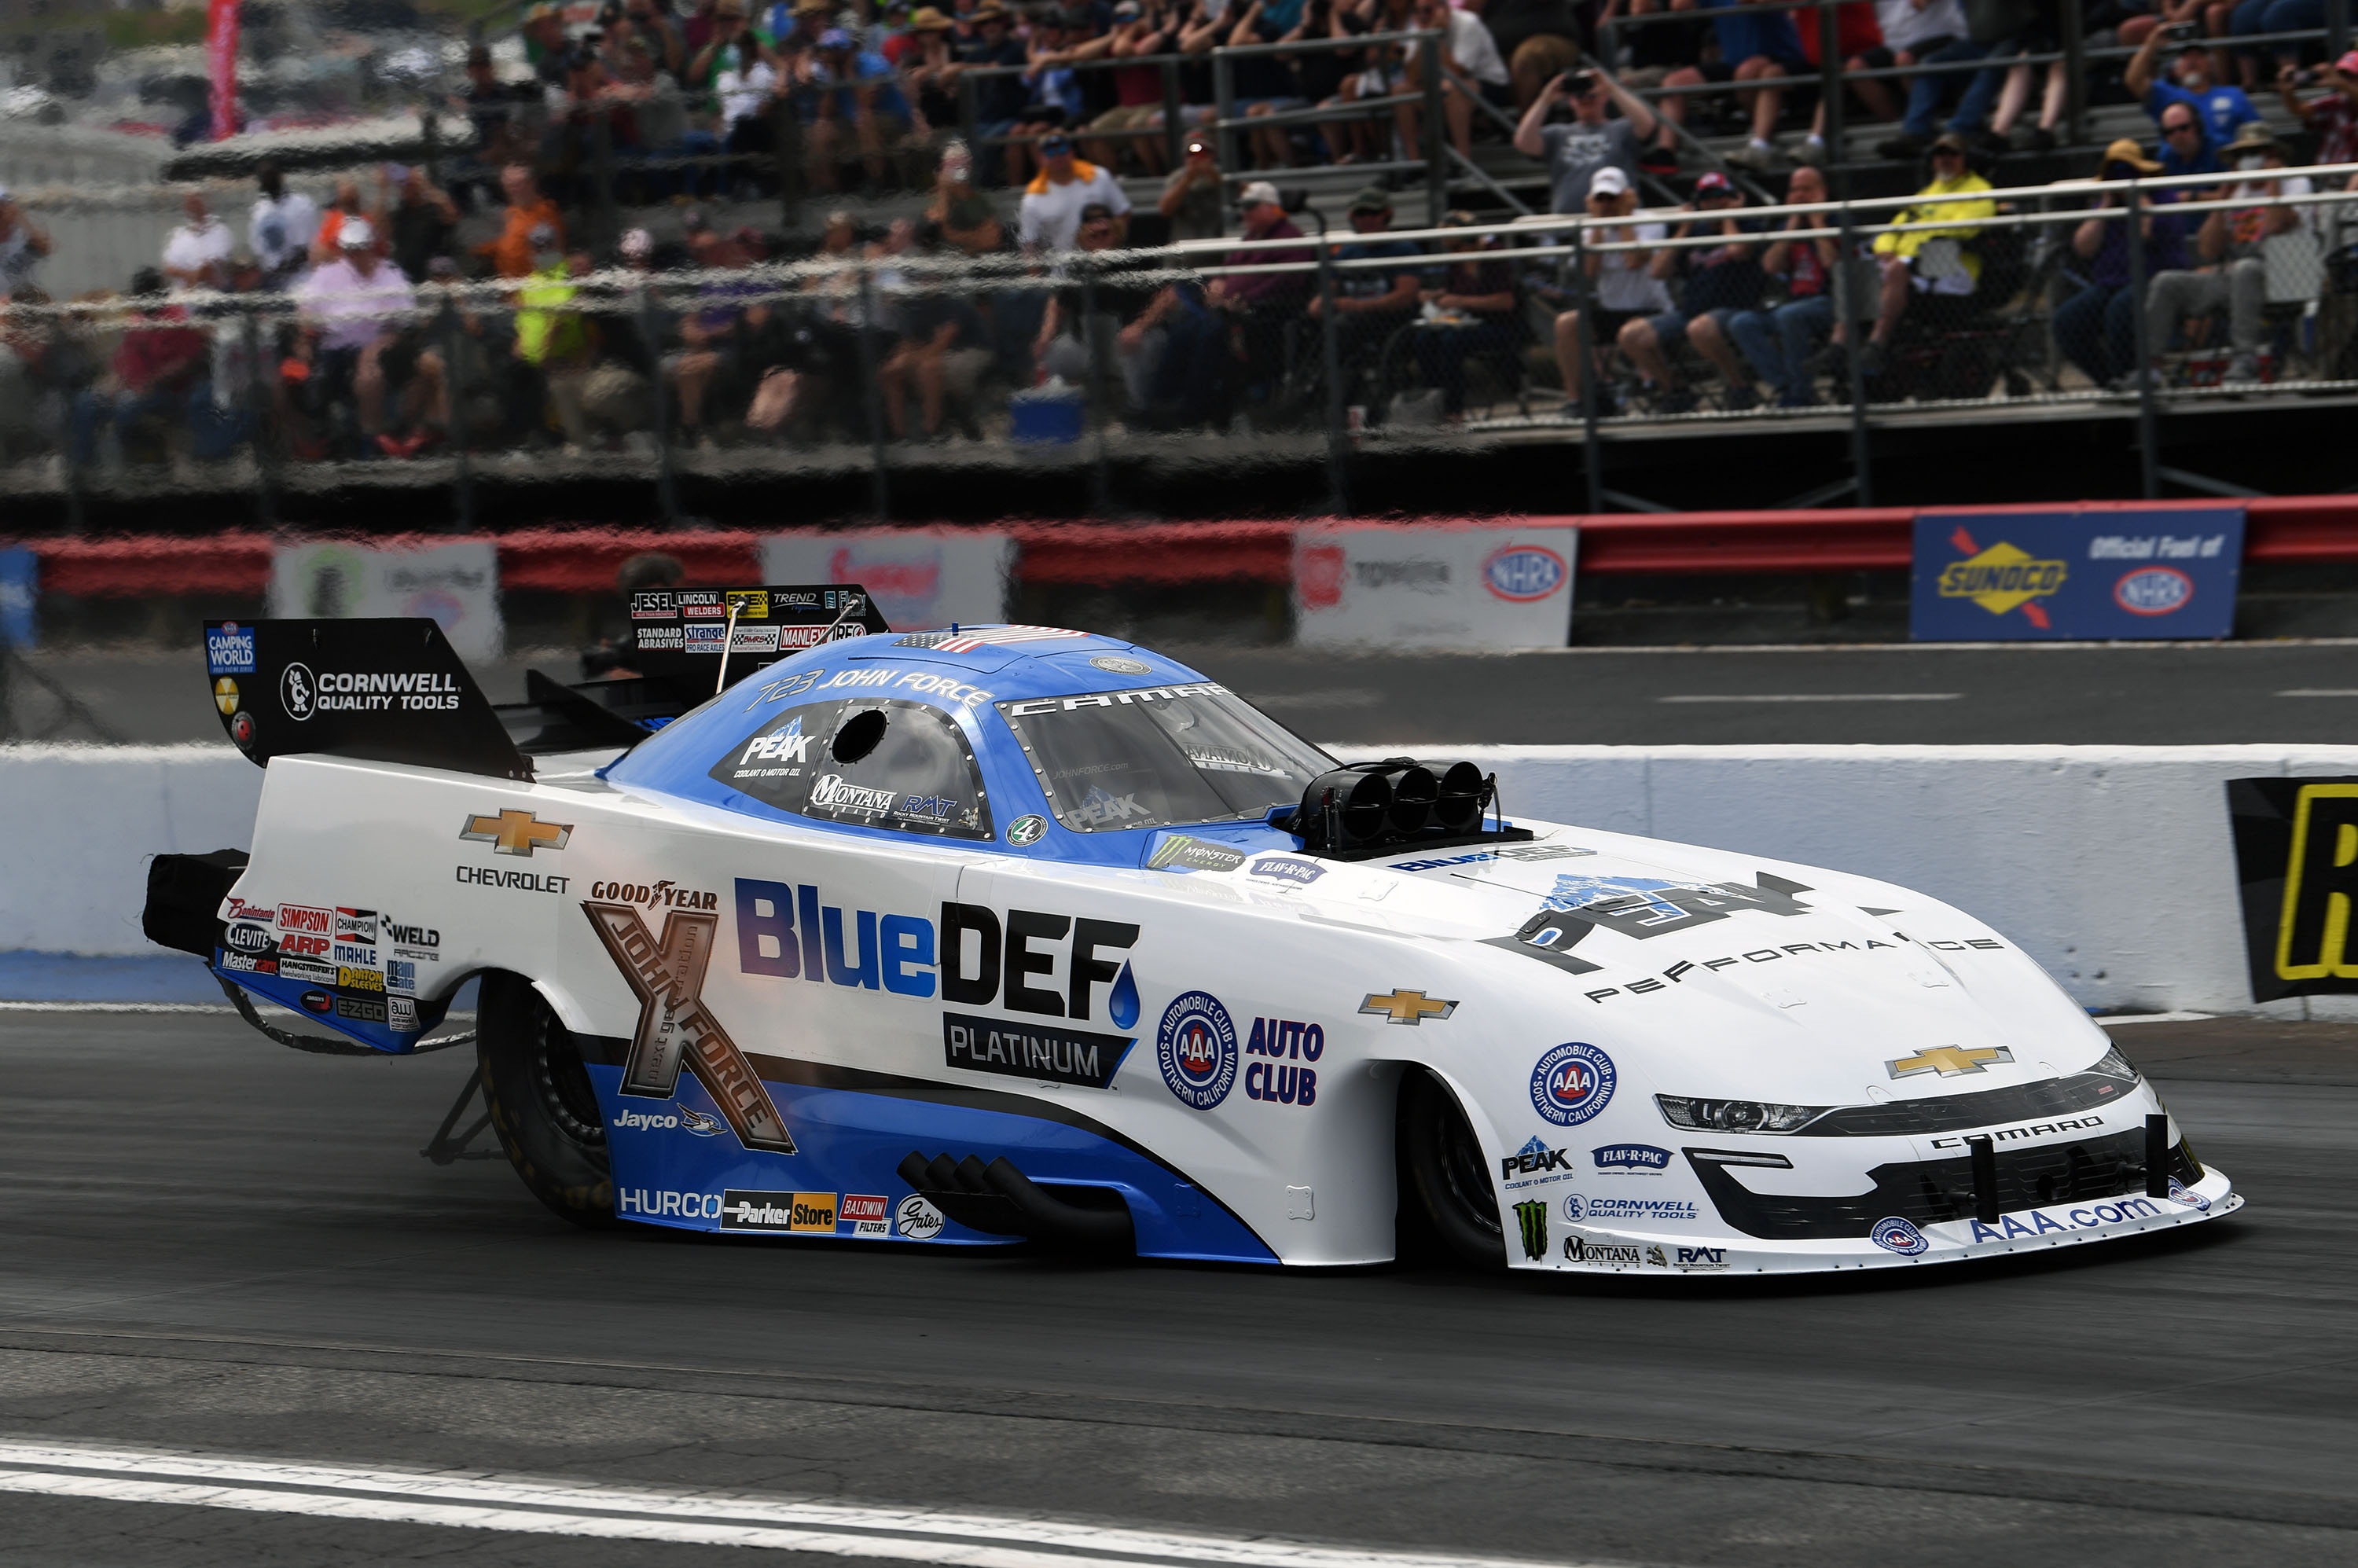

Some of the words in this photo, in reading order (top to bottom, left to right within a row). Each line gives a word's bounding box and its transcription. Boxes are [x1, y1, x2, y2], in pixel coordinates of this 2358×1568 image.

[1492, 553, 1555, 592] NHRA
[1942, 565, 2059, 591] SUNOCO
[630, 593, 677, 611] JESEL
[678, 594, 716, 604] LINCOLN
[774, 593, 817, 603] TREND
[687, 607, 722, 615] WELDERS
[209, 635, 252, 650] CAMPING
[637, 628, 682, 638] STANDARD
[638, 638, 684, 648] ABRASIVES
[685, 626, 725, 640] Strange
[210, 649, 253, 666] WORLD
[318, 673, 456, 692] CORNWELL
[744, 669, 825, 713] 723
[816, 669, 897, 690] JOHN
[894, 671, 995, 707] FORCE
[318, 696, 393, 711] QUALITY
[401, 696, 460, 710] TOOLS
[739, 734, 817, 766] PEAK
[733, 769, 762, 778] COOLANT
[788, 768, 801, 777] OIL
[1052, 762, 1129, 780] JOHNFORCE.com
[810, 774, 894, 810] MONTANA
[829, 805, 886, 818] BRAND
[900, 795, 957, 817] RMT
[1065, 792, 1151, 829] PEAK
[909, 812, 934, 821] MOUNTAIN
[1185, 857, 1227, 868] ENERGY
[456, 865, 570, 894] CHEVROLET
[280, 907, 330, 932] SIMPSON
[337, 918, 375, 934] CHAMPION
[227, 922, 270, 949] CLEVITE
[279, 934, 330, 955] ARP
[392, 924, 440, 948] WELD
[334, 945, 376, 965] MAHLE
[394, 949, 439, 961] RACING
[281, 960, 335, 975] HANGSTERFER'S
[281, 970, 312, 981] Metalworking
[312, 974, 336, 983] Lubricants
[338, 966, 384, 986] DARTON
[351, 979, 384, 992] SLEEVES
[647, 1036, 667, 1082] next
[659, 925, 699, 1034] geration
[611, 921, 689, 1010] JOHN
[678, 1011, 770, 1130] FORCE
[1163, 995, 1216, 1035] AUTOMOBILE
[1214, 1009, 1232, 1043] CLUB
[1179, 1033, 1216, 1063] AAA
[1245, 1016, 1325, 1063] AUTO
[950, 1025, 1101, 1079] PLATINUM
[1537, 1045, 1595, 1075] AUTOMOBILE
[1592, 1053, 1610, 1076] CLUB
[1159, 1042, 1195, 1104] SOUTHERN
[1196, 1052, 1236, 1106] CALIFORNIA
[1552, 1070, 1592, 1092] AAA
[1245, 1062, 1317, 1107] CLUB
[1533, 1081, 1566, 1123] SOUTHERN
[1567, 1081, 1614, 1123] CALIFORNIA
[613, 1109, 678, 1132] Jayco
[1930, 1115, 2105, 1150] CAMARO
[1501, 1148, 1574, 1181] PEAK
[1505, 1180, 1532, 1189] COOLANT
[1539, 1175, 1561, 1184] MOTOR
[619, 1187, 722, 1218] HURCO
[843, 1199, 884, 1217] BALDWIN
[1590, 1199, 1697, 1211] CORNWELL
[859, 1222, 887, 1233] FILTERS
[899, 1200, 943, 1235] Gates
[1969, 1199, 2162, 1244] AAA.com
[1874, 1220, 1905, 1239] AUTOMOBILE
[1564, 1236, 1641, 1262] MONTANA
[1887, 1236, 1912, 1244] AAA
[1677, 1246, 1727, 1263] RMT
